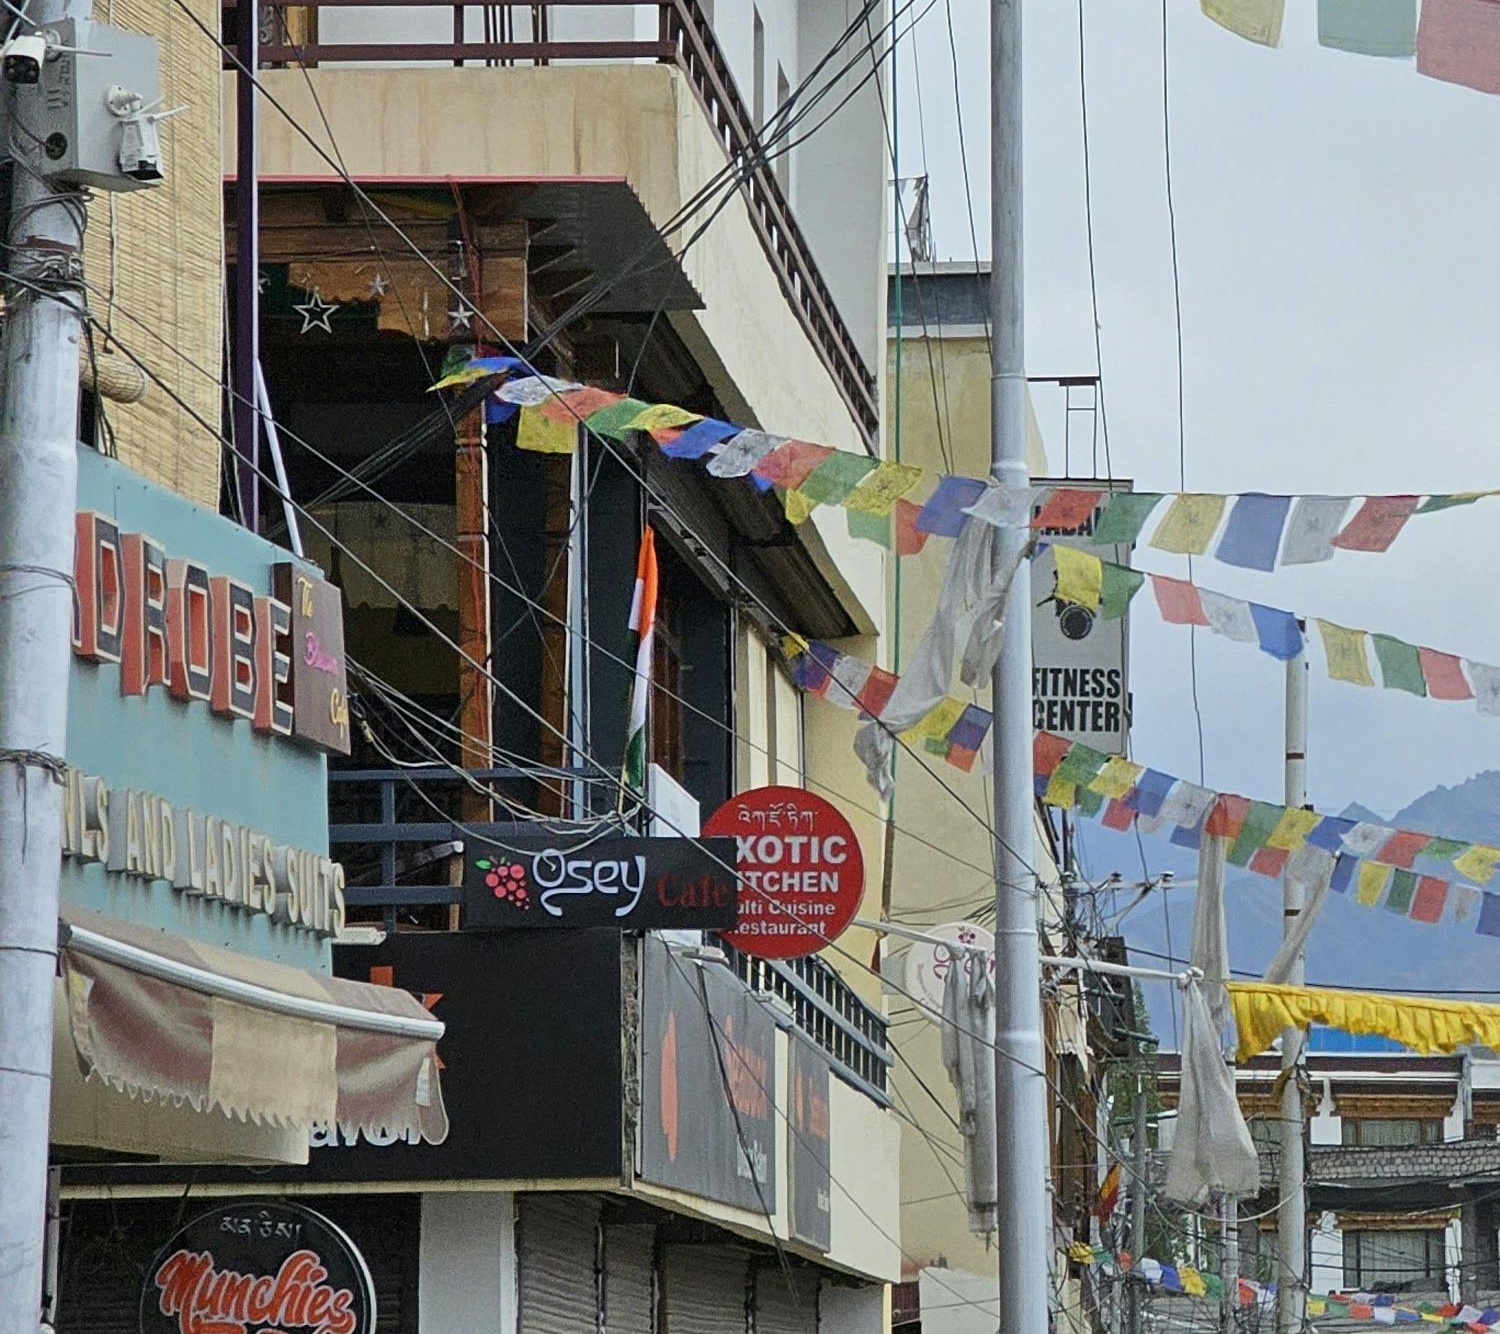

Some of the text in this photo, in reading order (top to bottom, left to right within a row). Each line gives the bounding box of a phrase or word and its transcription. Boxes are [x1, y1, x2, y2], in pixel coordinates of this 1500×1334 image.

[73, 510, 293, 736] DROBE
[1032, 667, 1121, 699] FITNESS
[1033, 700, 1121, 733] CENTER
[124, 787, 176, 882] AND
[186, 807, 277, 916] LADIES
[285, 845, 346, 938] SUITS
[732, 834, 848, 865] XOTIC
[736, 871, 840, 893] ITCHEN
[768, 899, 836, 916] Cuisine
[727, 920, 827, 936] estaurant
